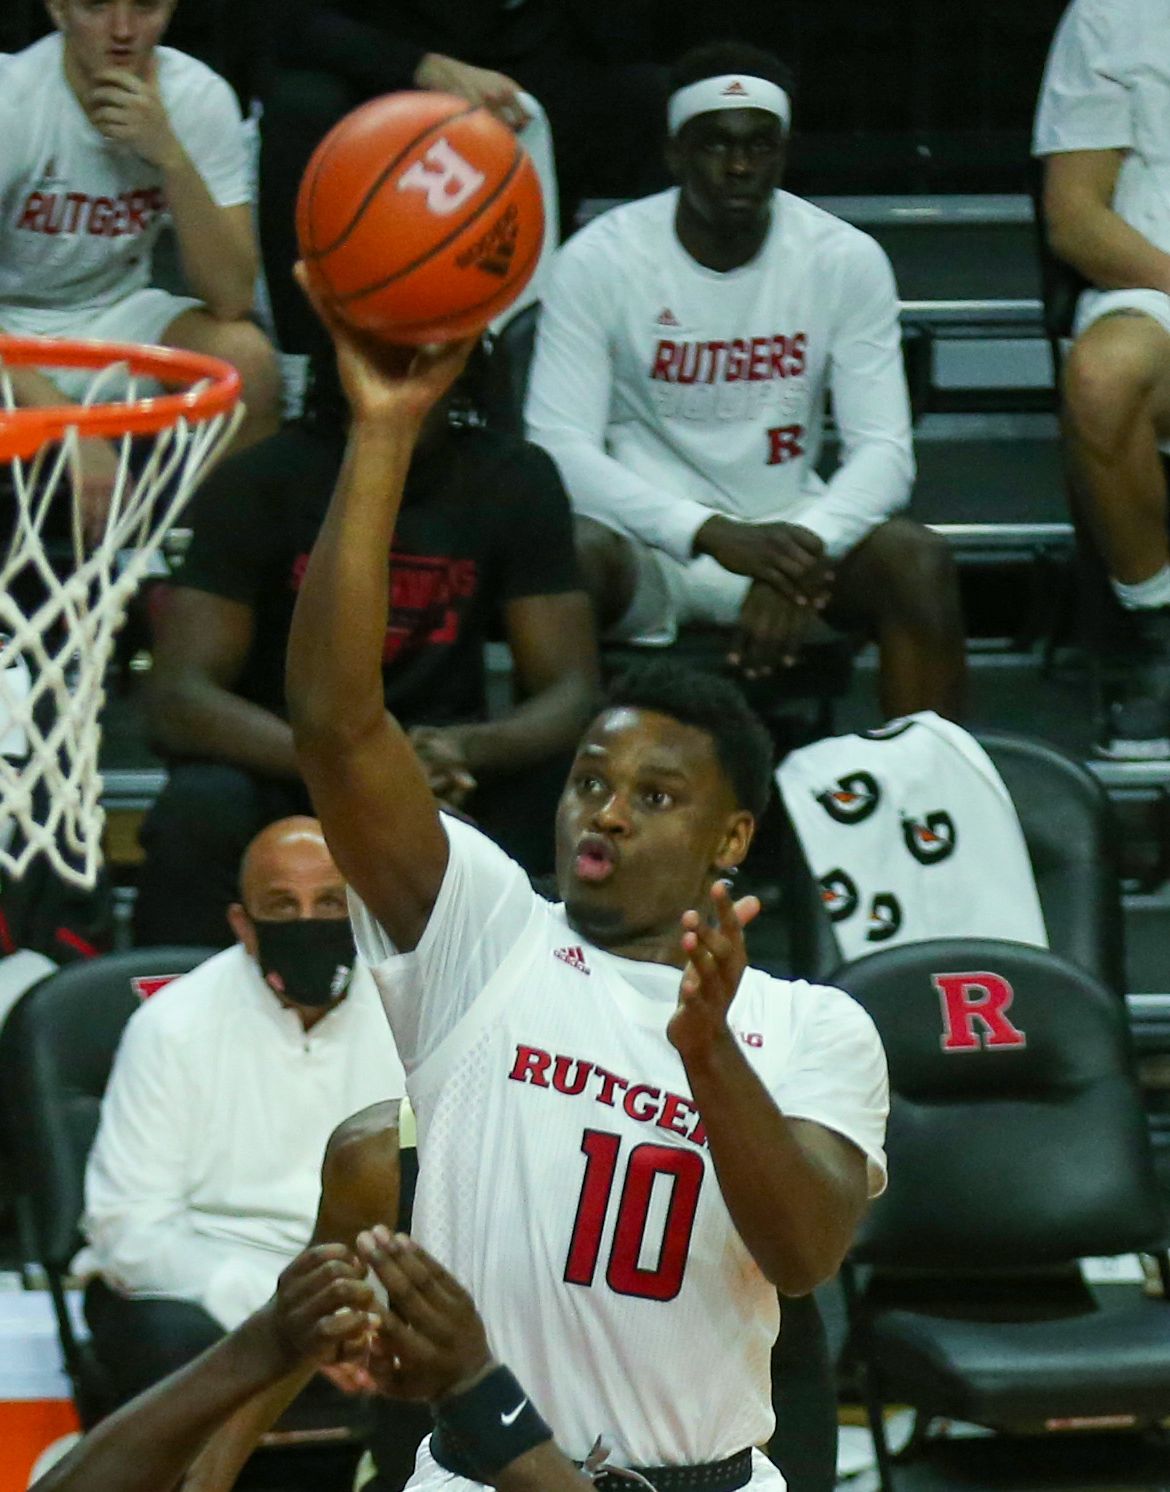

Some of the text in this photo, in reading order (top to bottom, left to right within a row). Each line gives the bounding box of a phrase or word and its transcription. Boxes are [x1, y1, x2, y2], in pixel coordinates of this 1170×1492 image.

[397, 137, 486, 216] R
[650, 332, 807, 384] RUTGERS
[930, 971, 1027, 1053] R
[563, 1127, 705, 1303] 10
